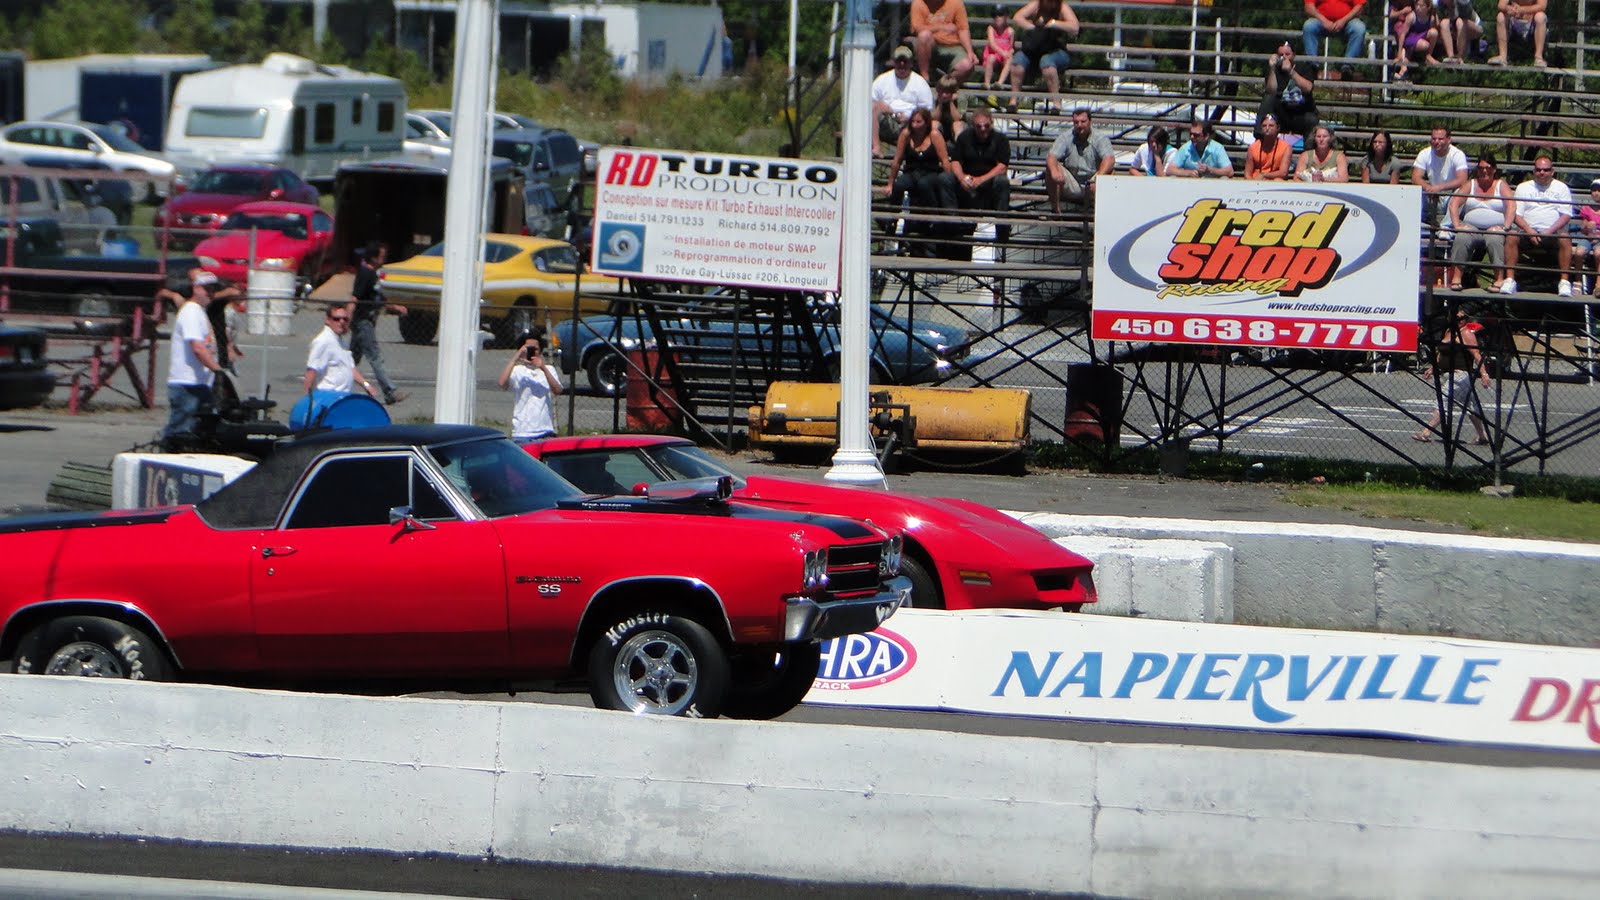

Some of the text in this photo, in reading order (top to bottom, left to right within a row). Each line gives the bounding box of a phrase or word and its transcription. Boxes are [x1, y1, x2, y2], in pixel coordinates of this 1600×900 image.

[605, 152, 837, 187] RD TURBO
[659, 174, 837, 201] PRODUCTION
[602, 190, 653, 207] Conception
[655, 195, 670, 208] sur
[671, 197, 704, 210] mesure
[705, 198, 718, 211] Kit
[721, 199, 745, 214] Turbo
[747, 201, 783, 217] Exhaust
[1228, 198, 1321, 207] PERFORMANCE
[606, 210, 704, 227] Daniel 514.791.1233
[718, 218, 830, 237] Richard 514.809.7992
[1173, 198, 1346, 248] fred
[734, 239, 746, 249] de
[749, 241, 784, 252] moteur
[787, 242, 817, 254] SWAP
[766, 257, 827, 270] d'ordinateur
[1158, 235, 1341, 297] shop
[655, 264, 679, 275] 1320,
[682, 267, 695, 276] rue
[699, 267, 752, 281] Gay-Lussac
[784, 273, 828, 287] Longueuil
[1156, 277, 1290, 300] Racing
[1267, 301, 1396, 316] www.fredshopracing.com
[1110, 317, 1398, 346] 450 638-7770
[537, 583, 561, 593] SS
[605, 609, 670, 646] Hoosier
[820, 633, 891, 677] HRA
[811, 682, 850, 690] RACK
[990, 651, 1502, 723] NAPIERVILLE
